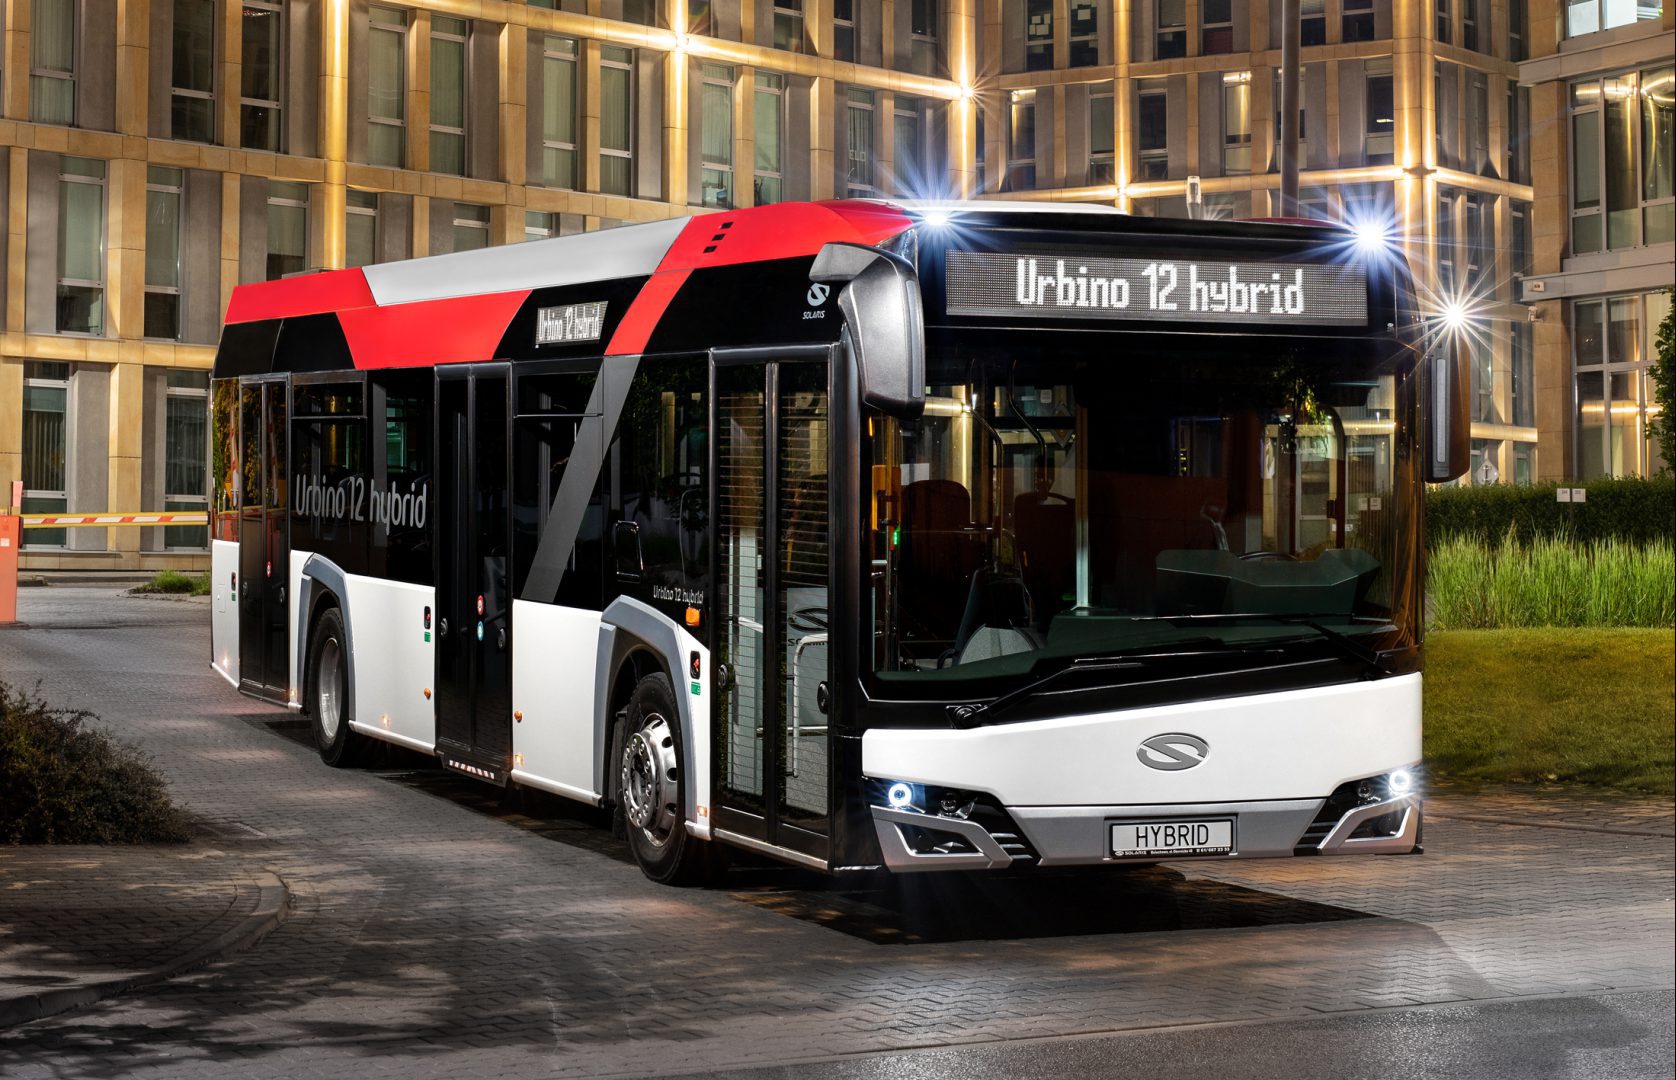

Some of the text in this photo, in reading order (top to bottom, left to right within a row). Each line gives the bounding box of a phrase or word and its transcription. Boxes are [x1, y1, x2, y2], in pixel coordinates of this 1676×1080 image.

[1015, 259, 1304, 314] Urbino 12 hybrid
[539, 309, 562, 341] Urbino
[564, 306, 573, 340] 12
[802, 310, 826, 319] SOLARIS
[295, 474, 427, 536] Urbino 12 hybrid
[653, 585, 704, 608] Urbino 12 hybrid
[1136, 824, 1209, 848] HYBRID
